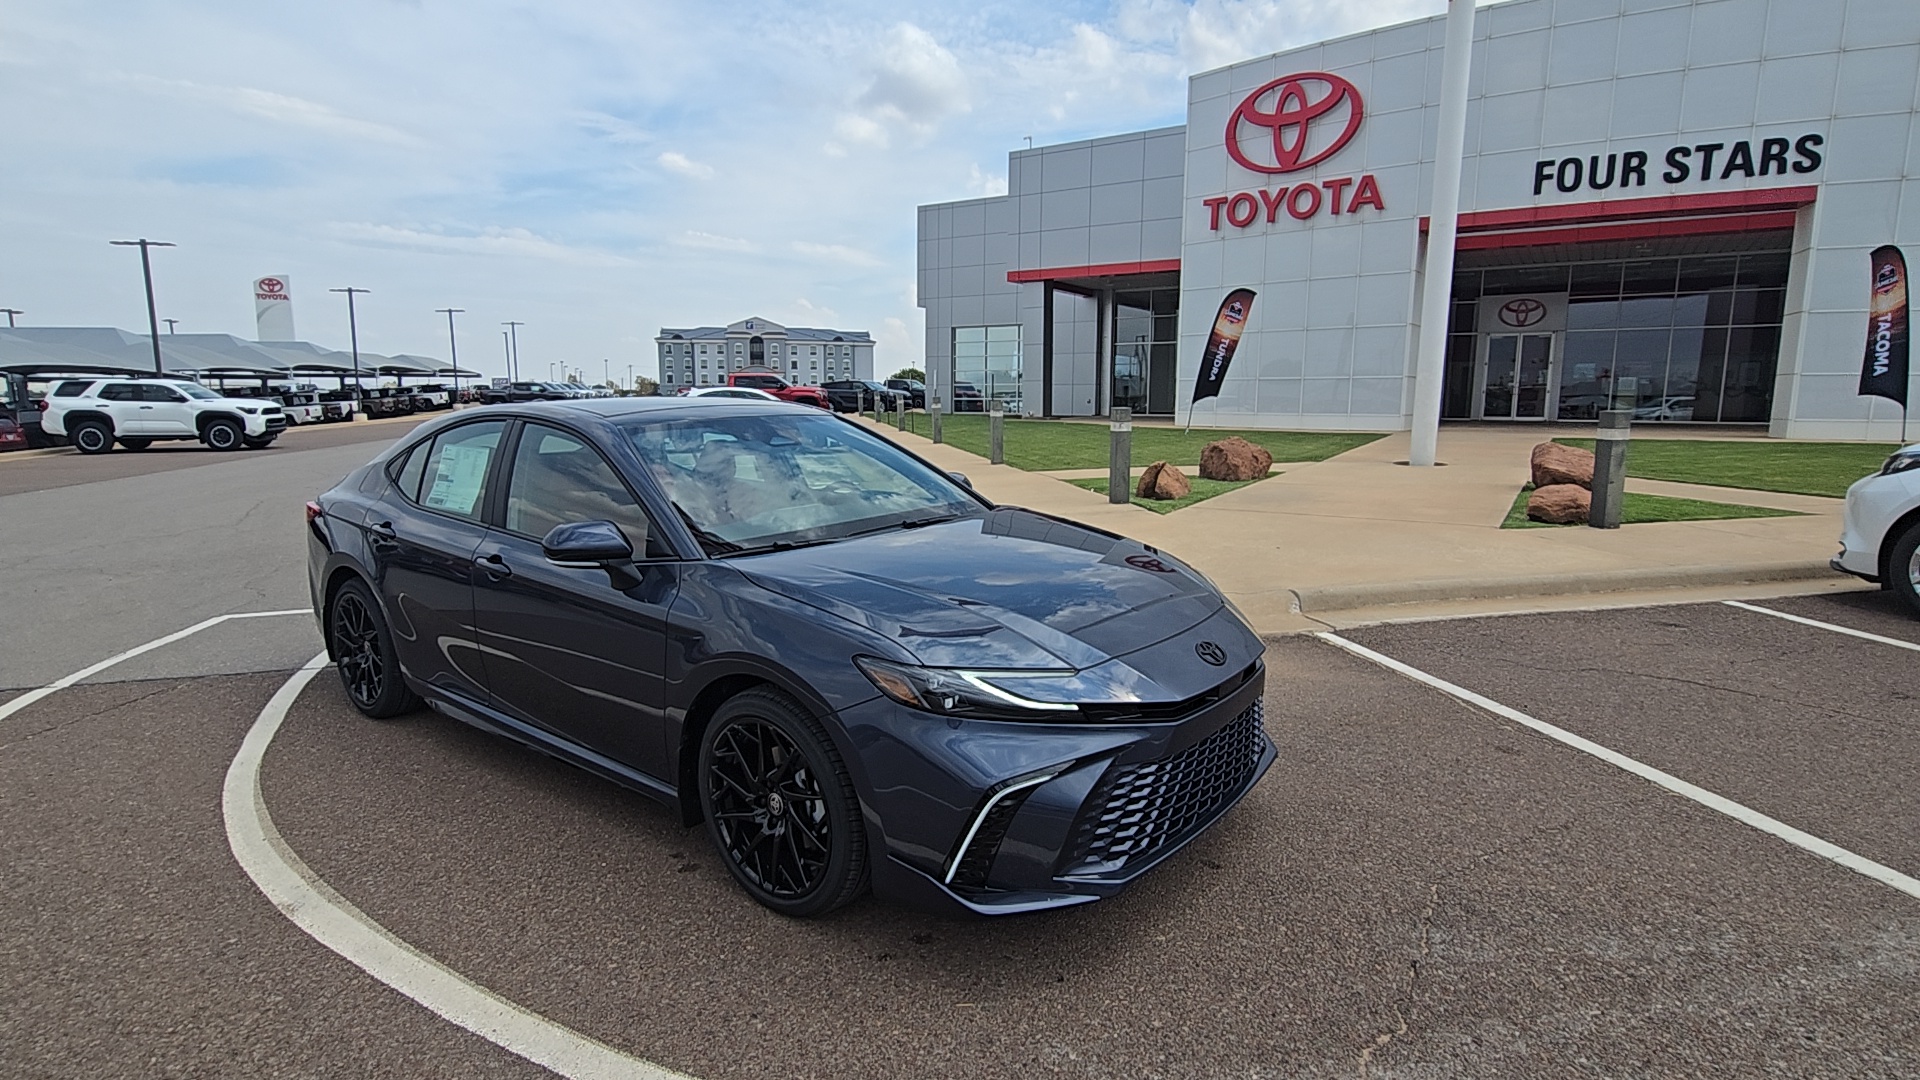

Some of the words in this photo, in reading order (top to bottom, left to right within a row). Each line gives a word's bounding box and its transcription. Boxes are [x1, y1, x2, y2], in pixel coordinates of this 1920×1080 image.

[1533, 150, 1648, 195] FOUR
[1663, 134, 1824, 184] STARS
[1203, 174, 1385, 230] TOYOTA
[255, 293, 289, 301] TOYOTA
[1208, 338, 1230, 381] TUNDRA
[1872, 313, 1893, 377] TACOMA
